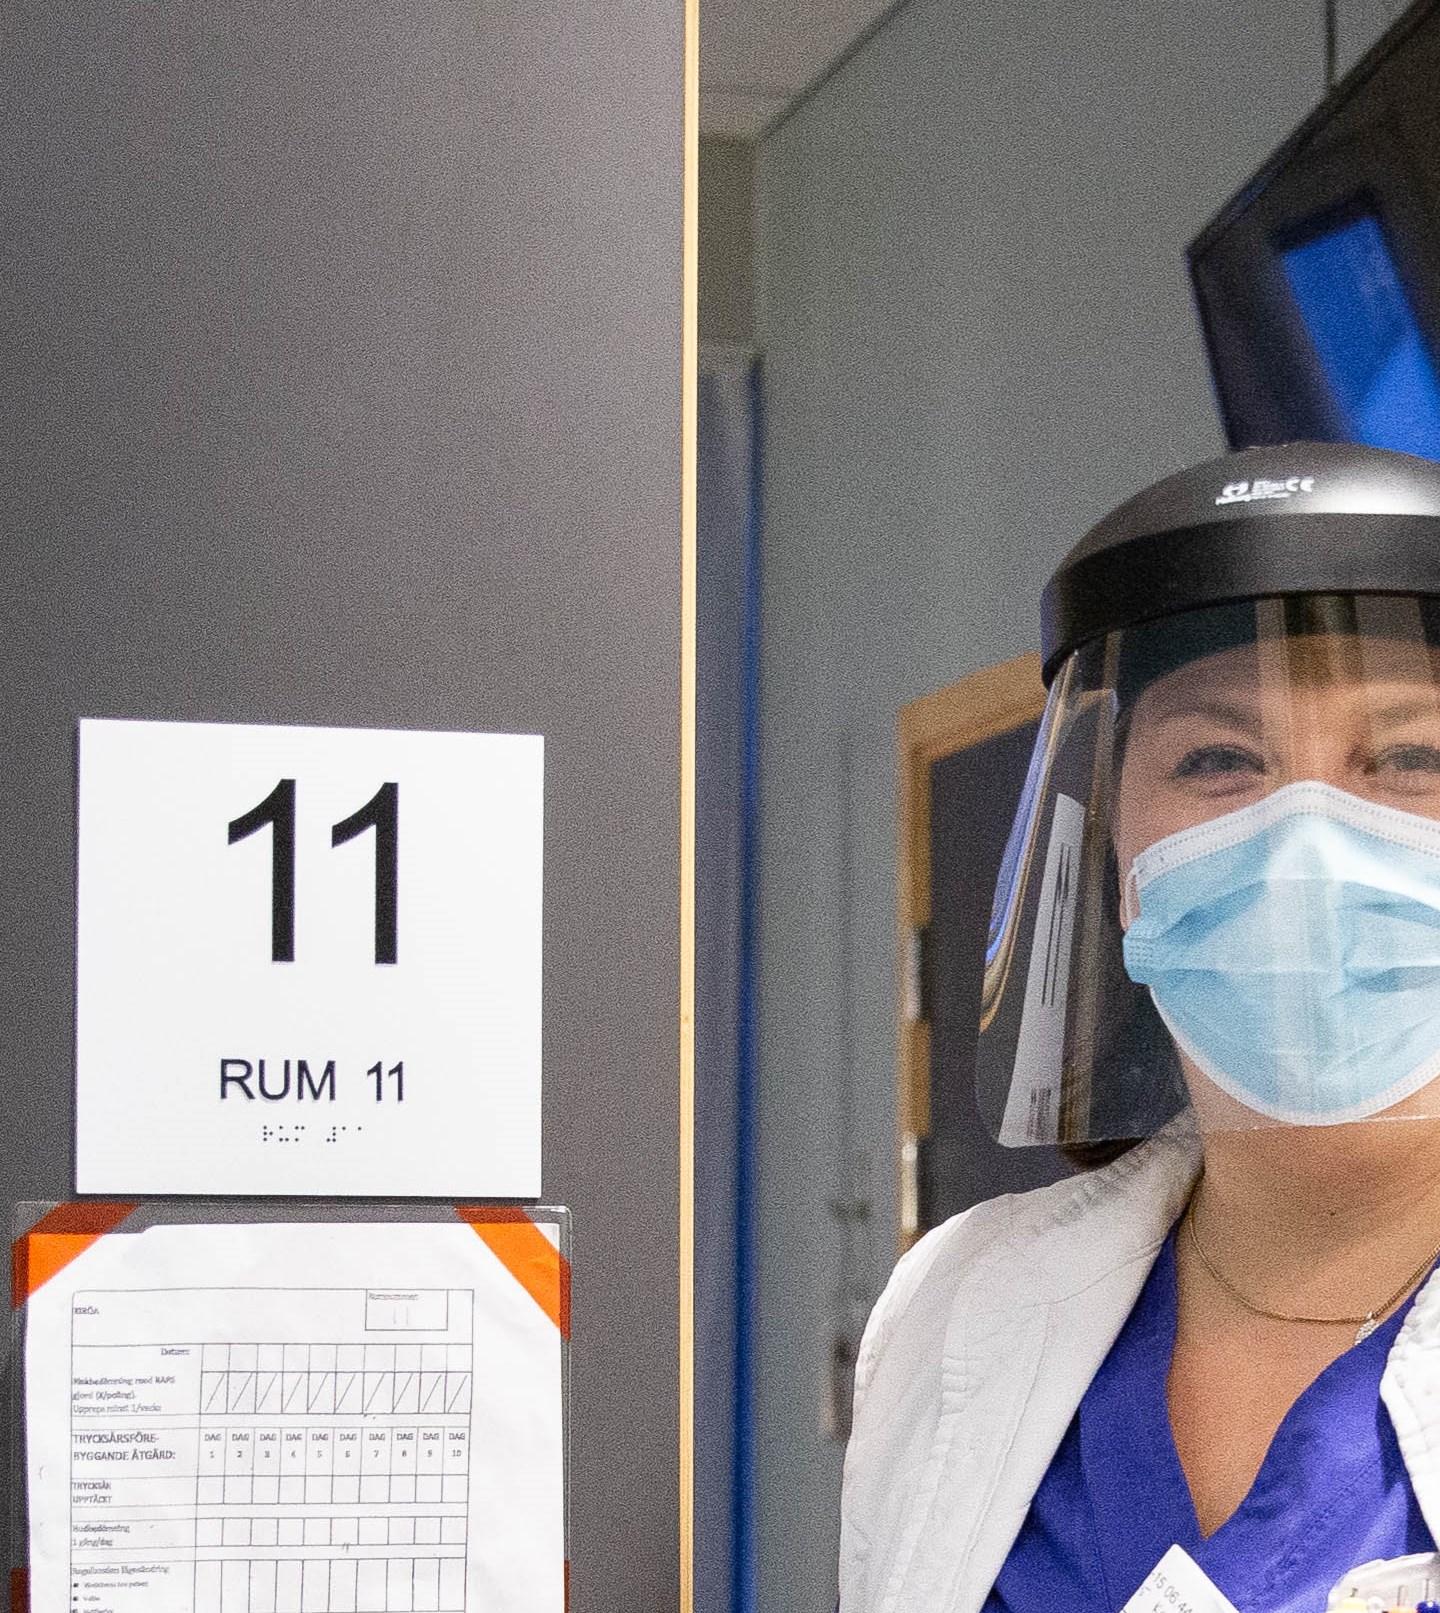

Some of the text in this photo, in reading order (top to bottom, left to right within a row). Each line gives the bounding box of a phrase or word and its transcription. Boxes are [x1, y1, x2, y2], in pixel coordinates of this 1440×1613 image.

[228, 779, 398, 964] 11
[219, 1058, 404, 1102] RUM 11
[73, 1431, 160, 1444] TRYCKSÅRSFÖRE-
[205, 1433, 465, 1441] DAG DAG DAG DAG DAG DAG DAG DAG DAG DAG
[73, 1451, 129, 1460] BYGGANDE
